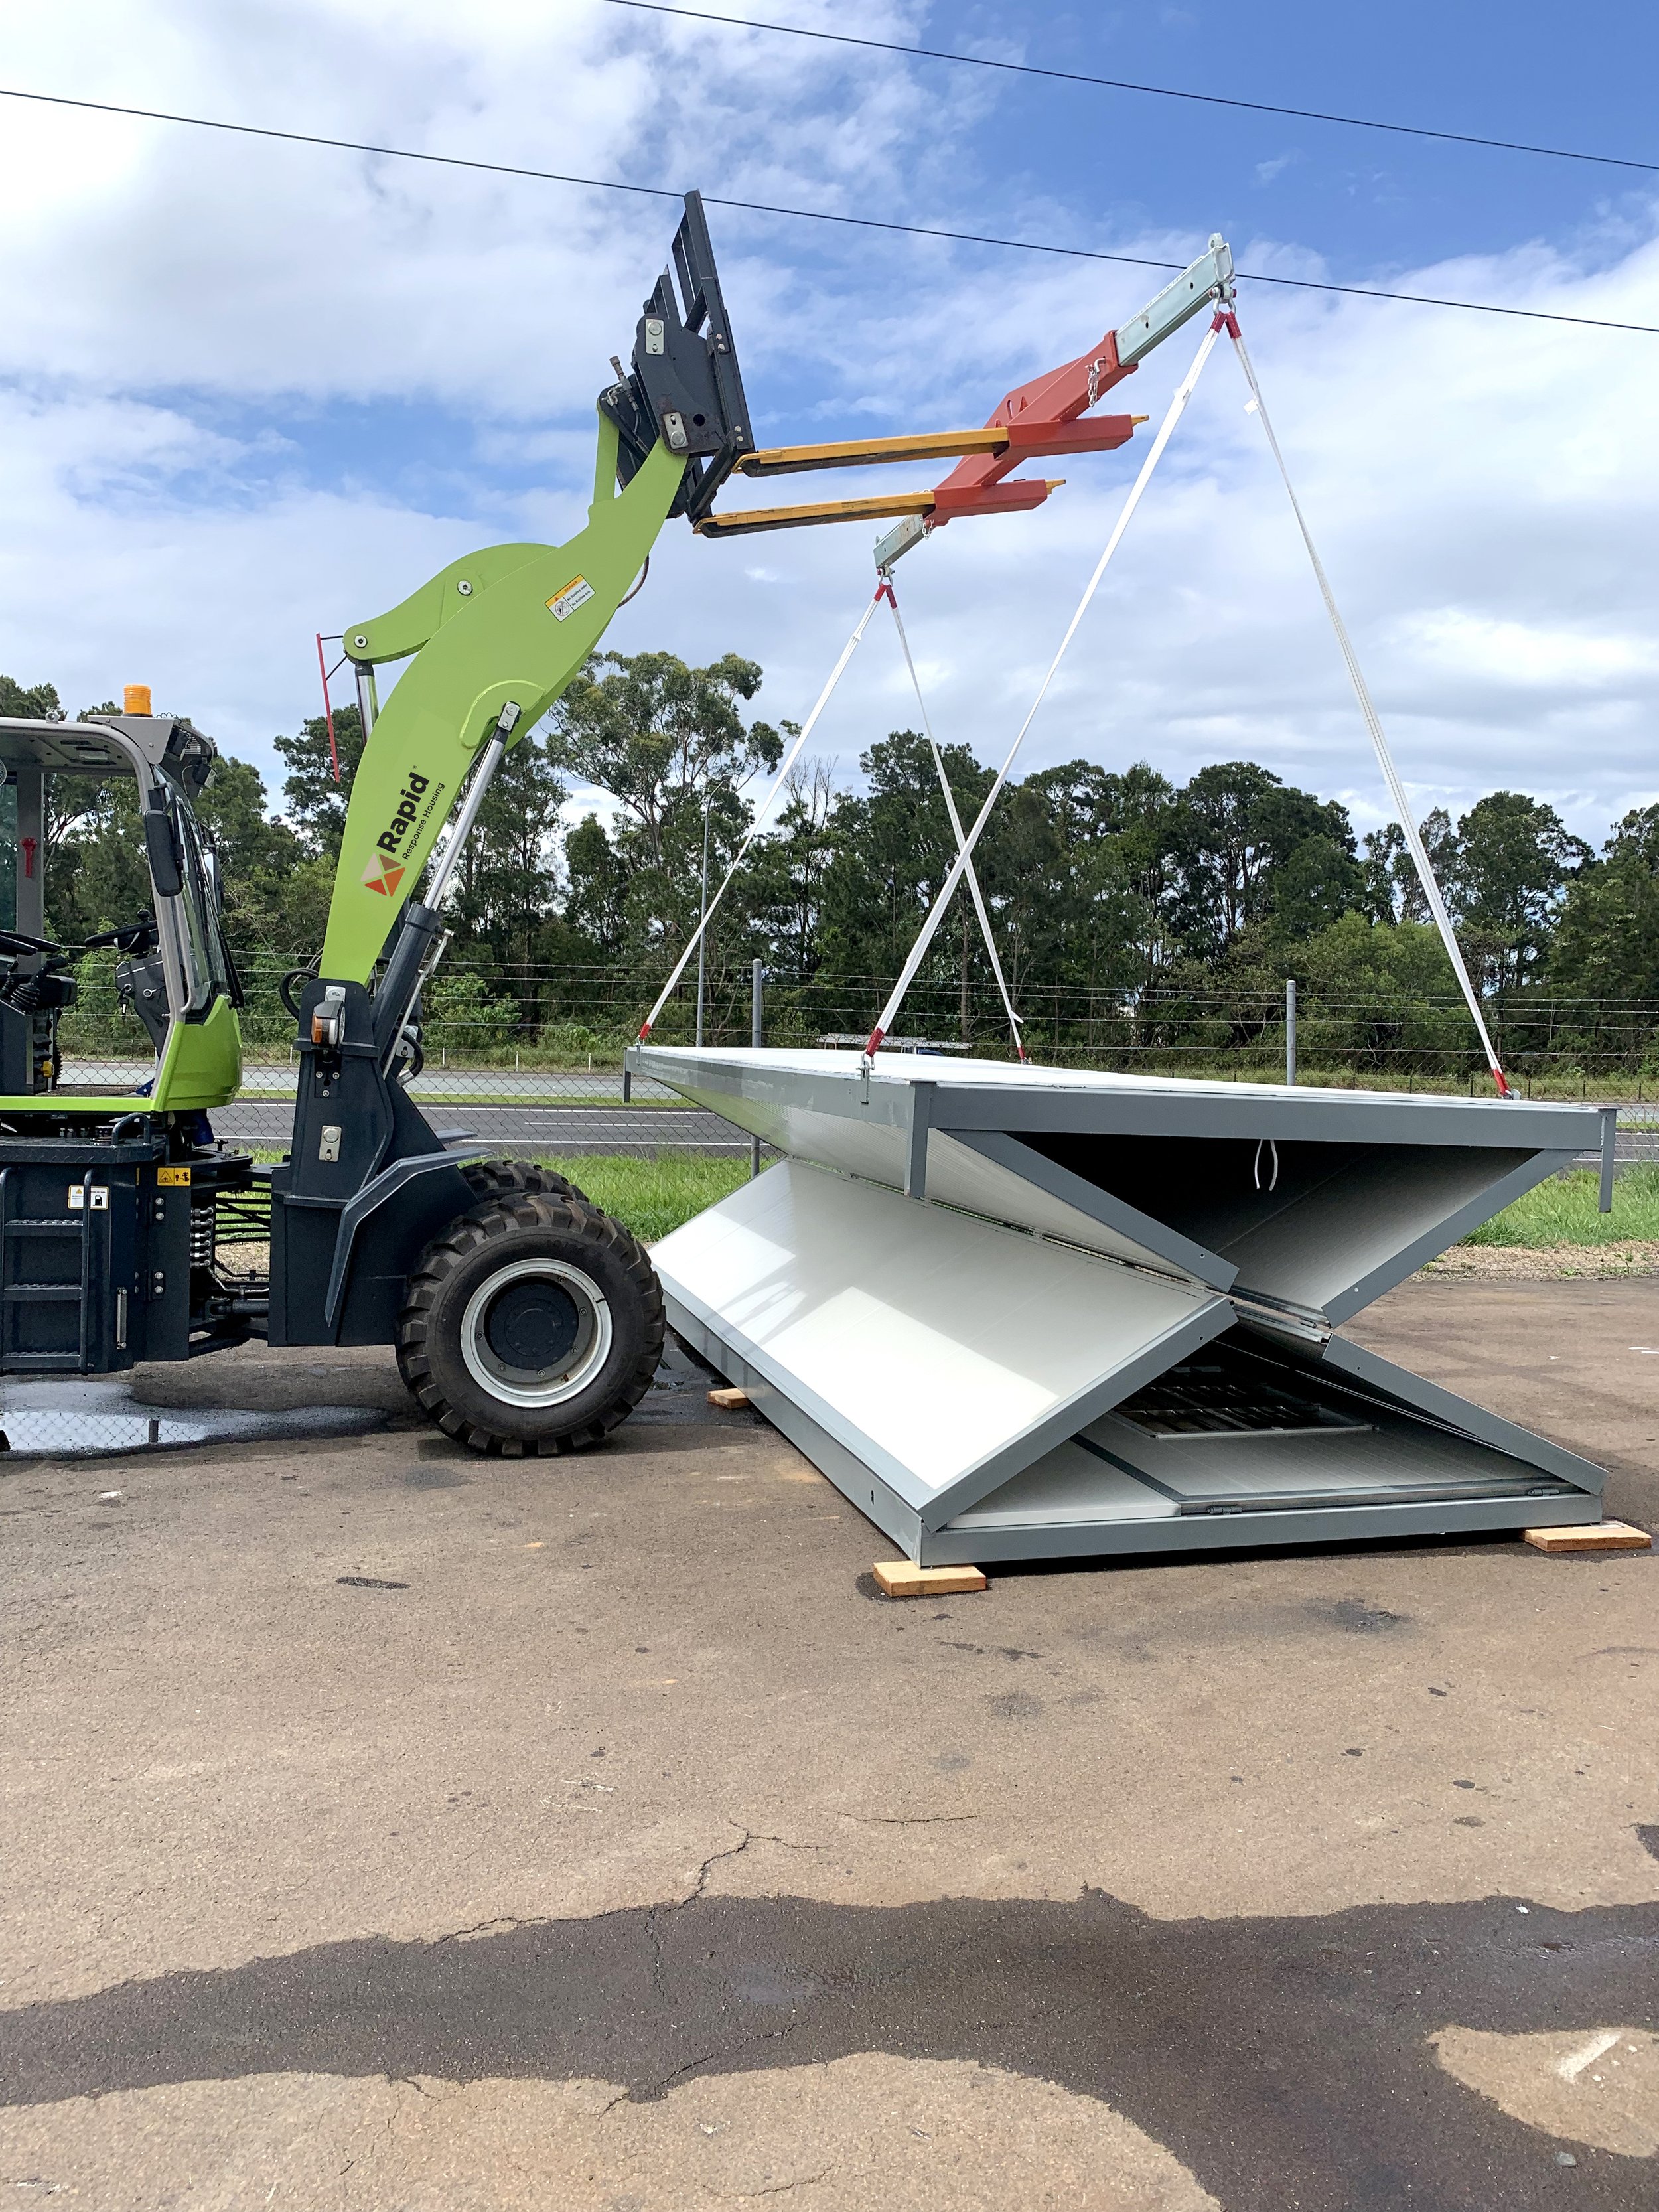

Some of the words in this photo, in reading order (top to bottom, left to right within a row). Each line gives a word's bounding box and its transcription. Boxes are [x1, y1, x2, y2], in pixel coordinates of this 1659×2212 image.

[376, 771, 429, 854] Rapid
[402, 819, 427, 860] Response
[423, 782, 445, 818] Housing
